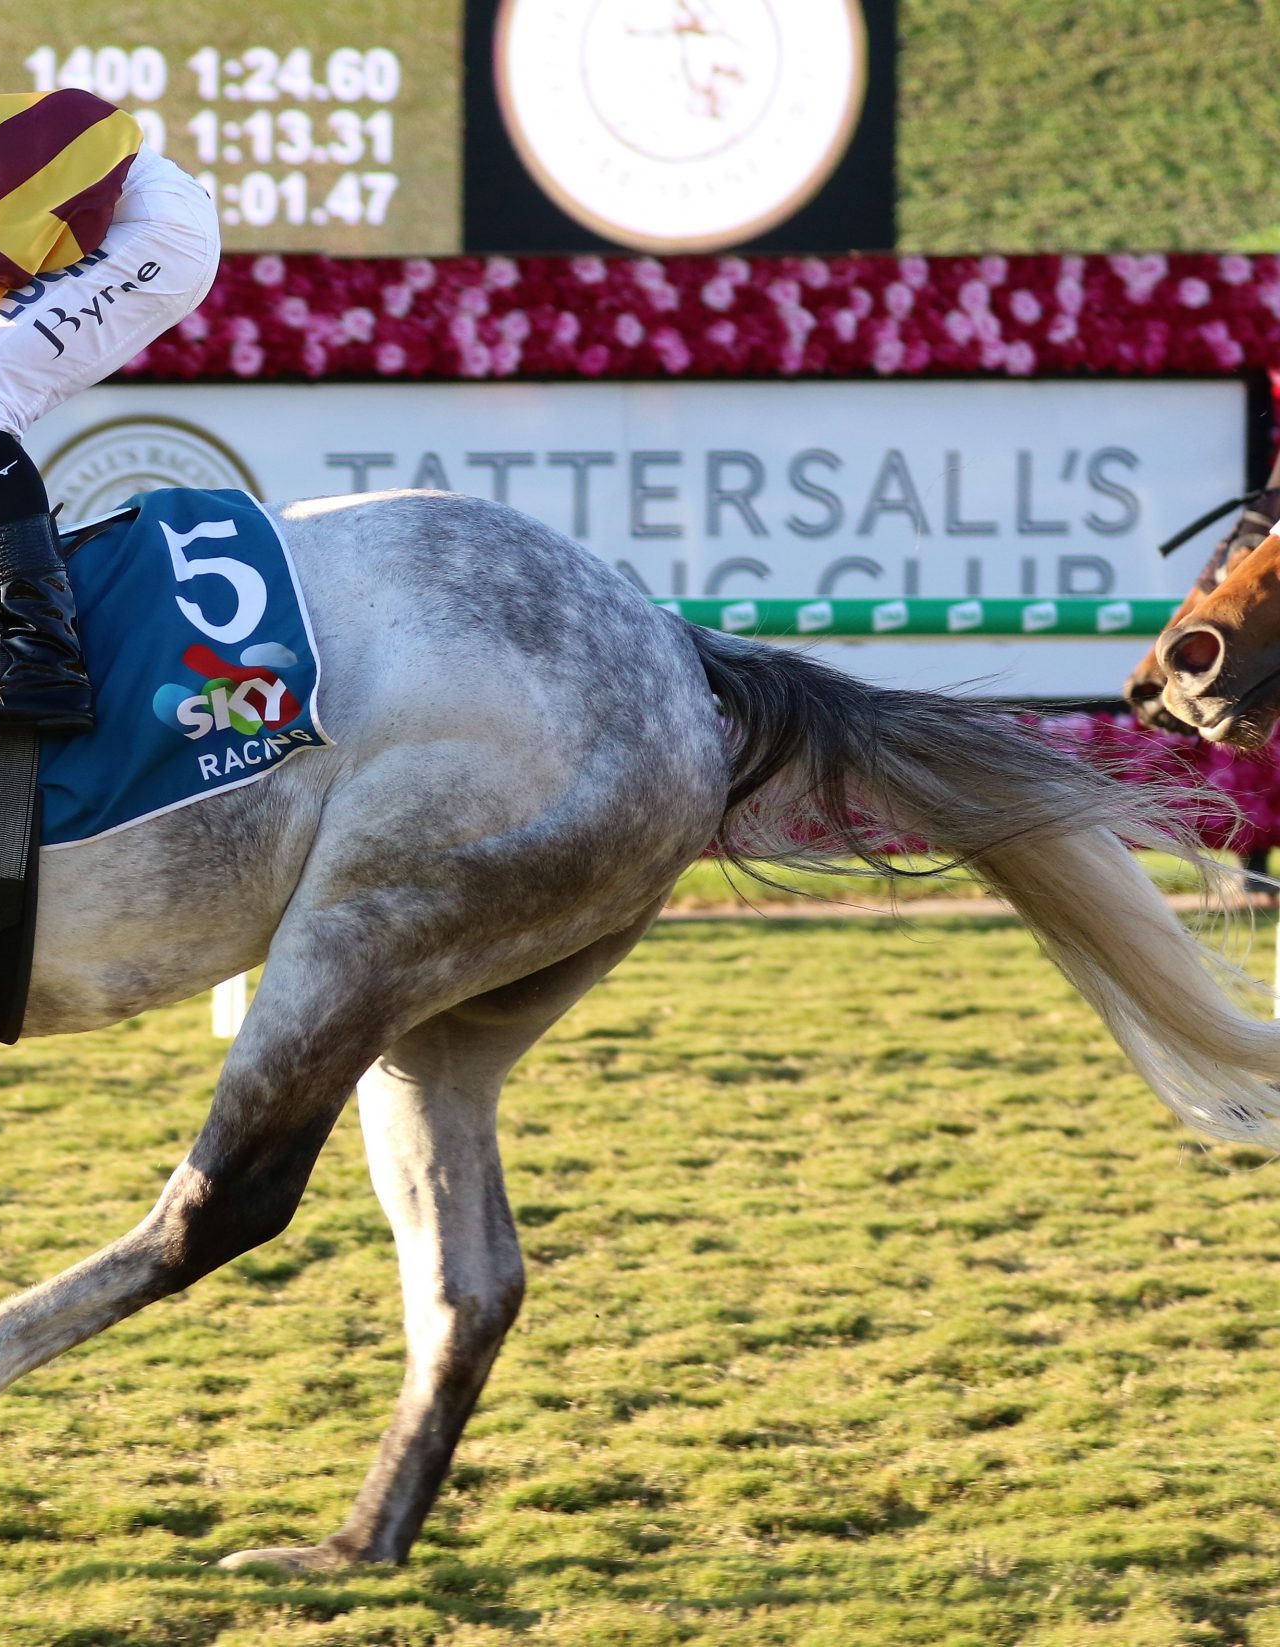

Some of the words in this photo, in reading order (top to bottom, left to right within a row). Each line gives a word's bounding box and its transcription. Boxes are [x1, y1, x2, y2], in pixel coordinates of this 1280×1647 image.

[25, 46, 168, 101] 1400
[186, 46, 401, 102] 1:24.60
[186, 109, 395, 165] 1:13.31
[158, 519, 267, 644] 5
[176, 677, 287, 740] SKY
[197, 729, 313, 781] RACING
